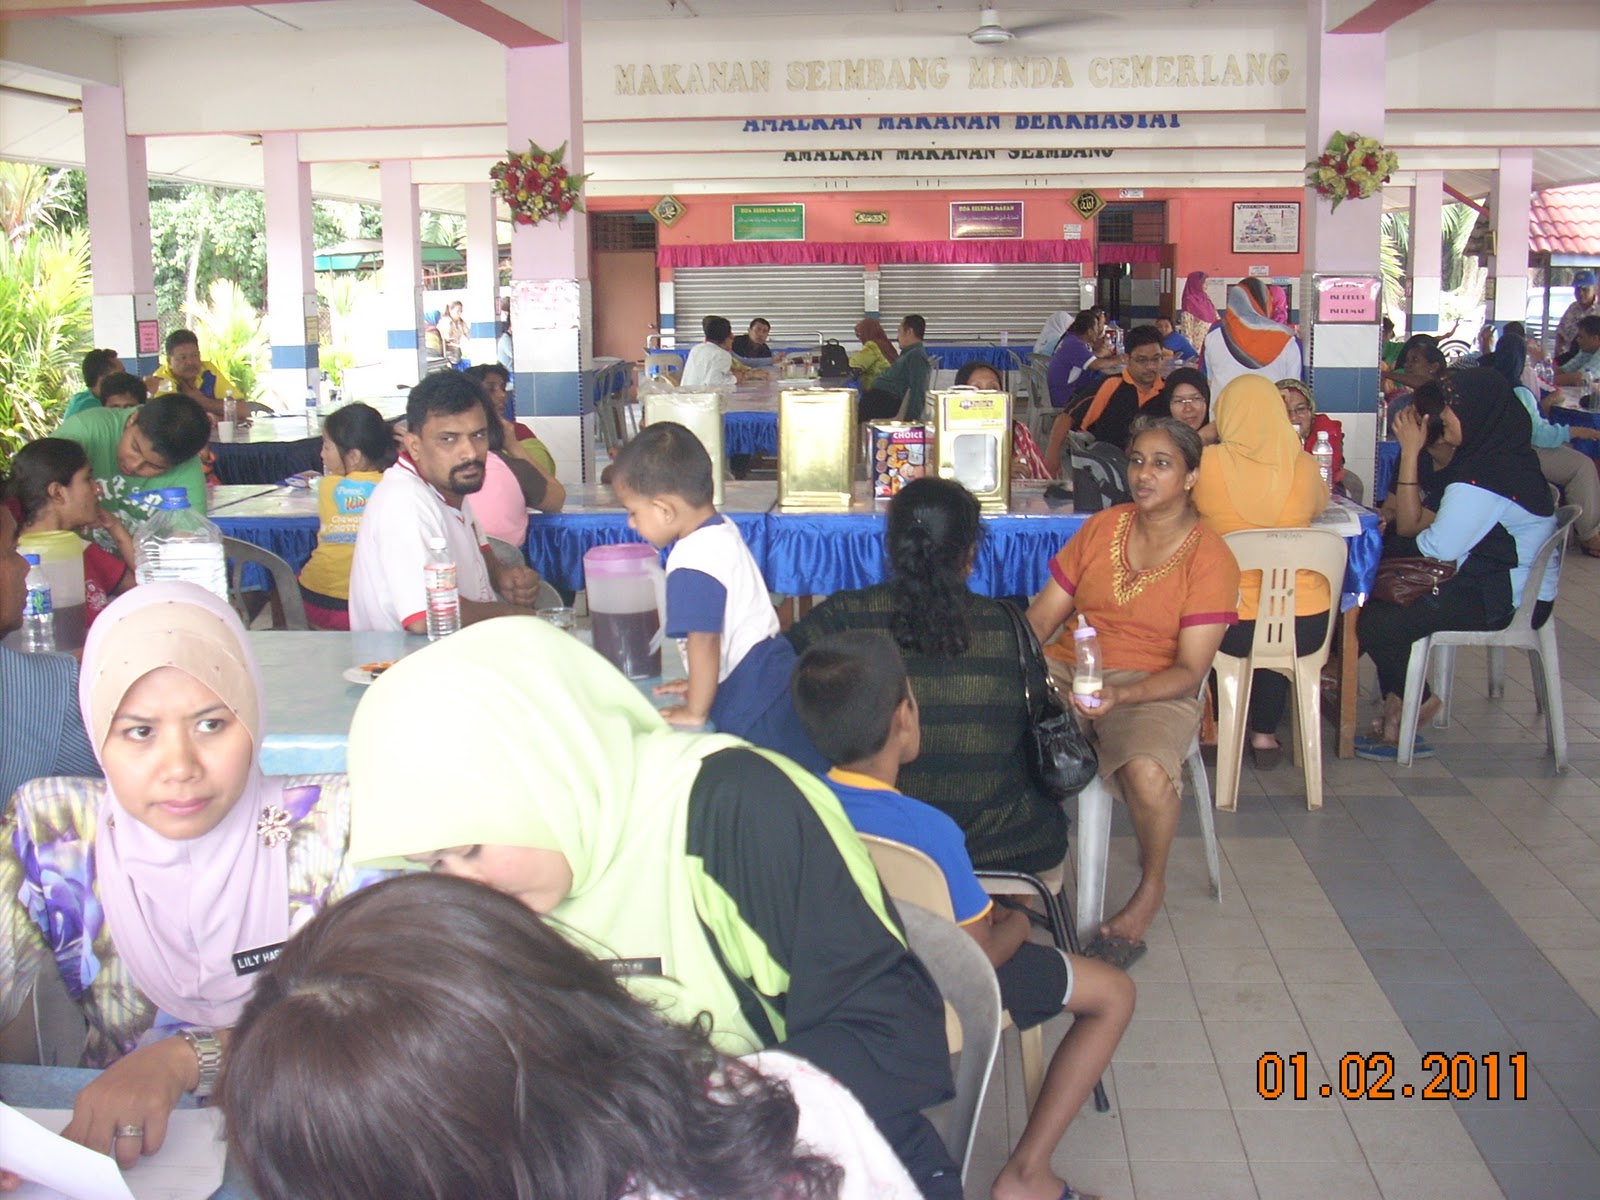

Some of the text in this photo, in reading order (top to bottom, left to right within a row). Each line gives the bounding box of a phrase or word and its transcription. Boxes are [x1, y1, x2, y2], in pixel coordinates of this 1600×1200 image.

[614, 52, 1291, 96] MAKANAN SEIMBANG MINDA CEMERLANG
[742, 117, 863, 132] AMALKAN
[877, 115, 1001, 131] MAKANAN
[783, 150, 883, 162] AMALKAN
[895, 149, 996, 161] MAKANAN
[892, 431, 923, 439] CHOICE
[237, 954, 261, 969] LILY
